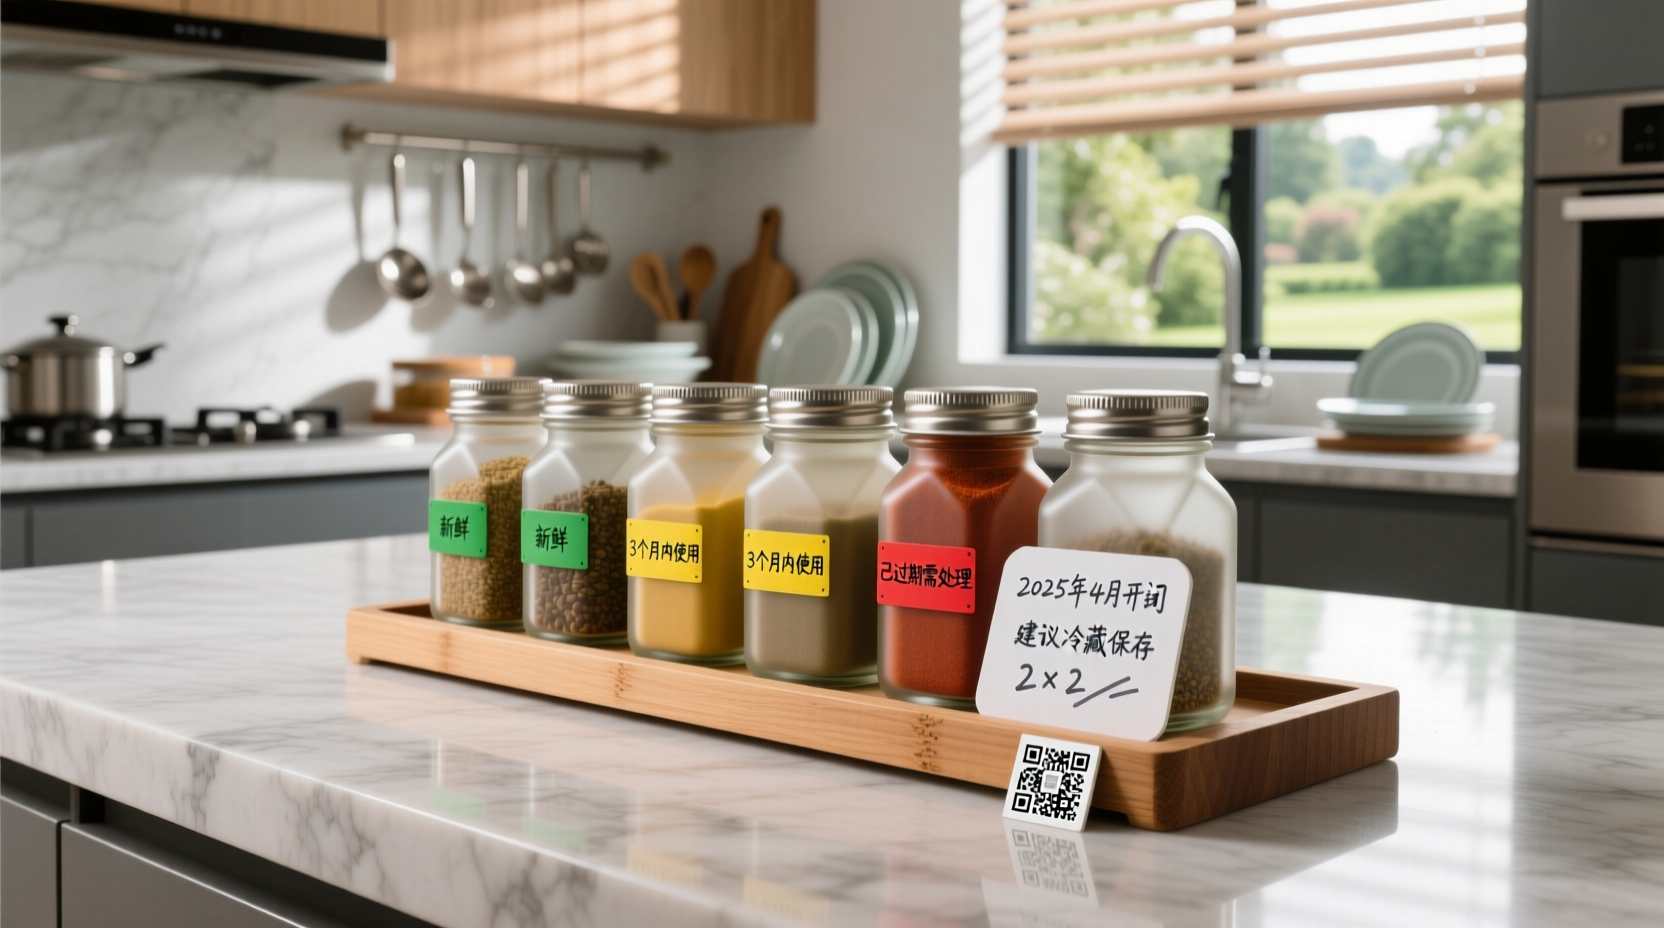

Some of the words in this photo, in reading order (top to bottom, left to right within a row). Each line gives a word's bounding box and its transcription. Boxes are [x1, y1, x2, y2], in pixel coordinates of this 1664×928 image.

[439, 515, 470, 541] 新鲜
[535, 524, 569, 553] 新鲜
[630, 539, 700, 564] 3个月内使用
[747, 550, 824, 576] 3个月内使用
[1014, 619, 1155, 661] 建议冷藏保存
